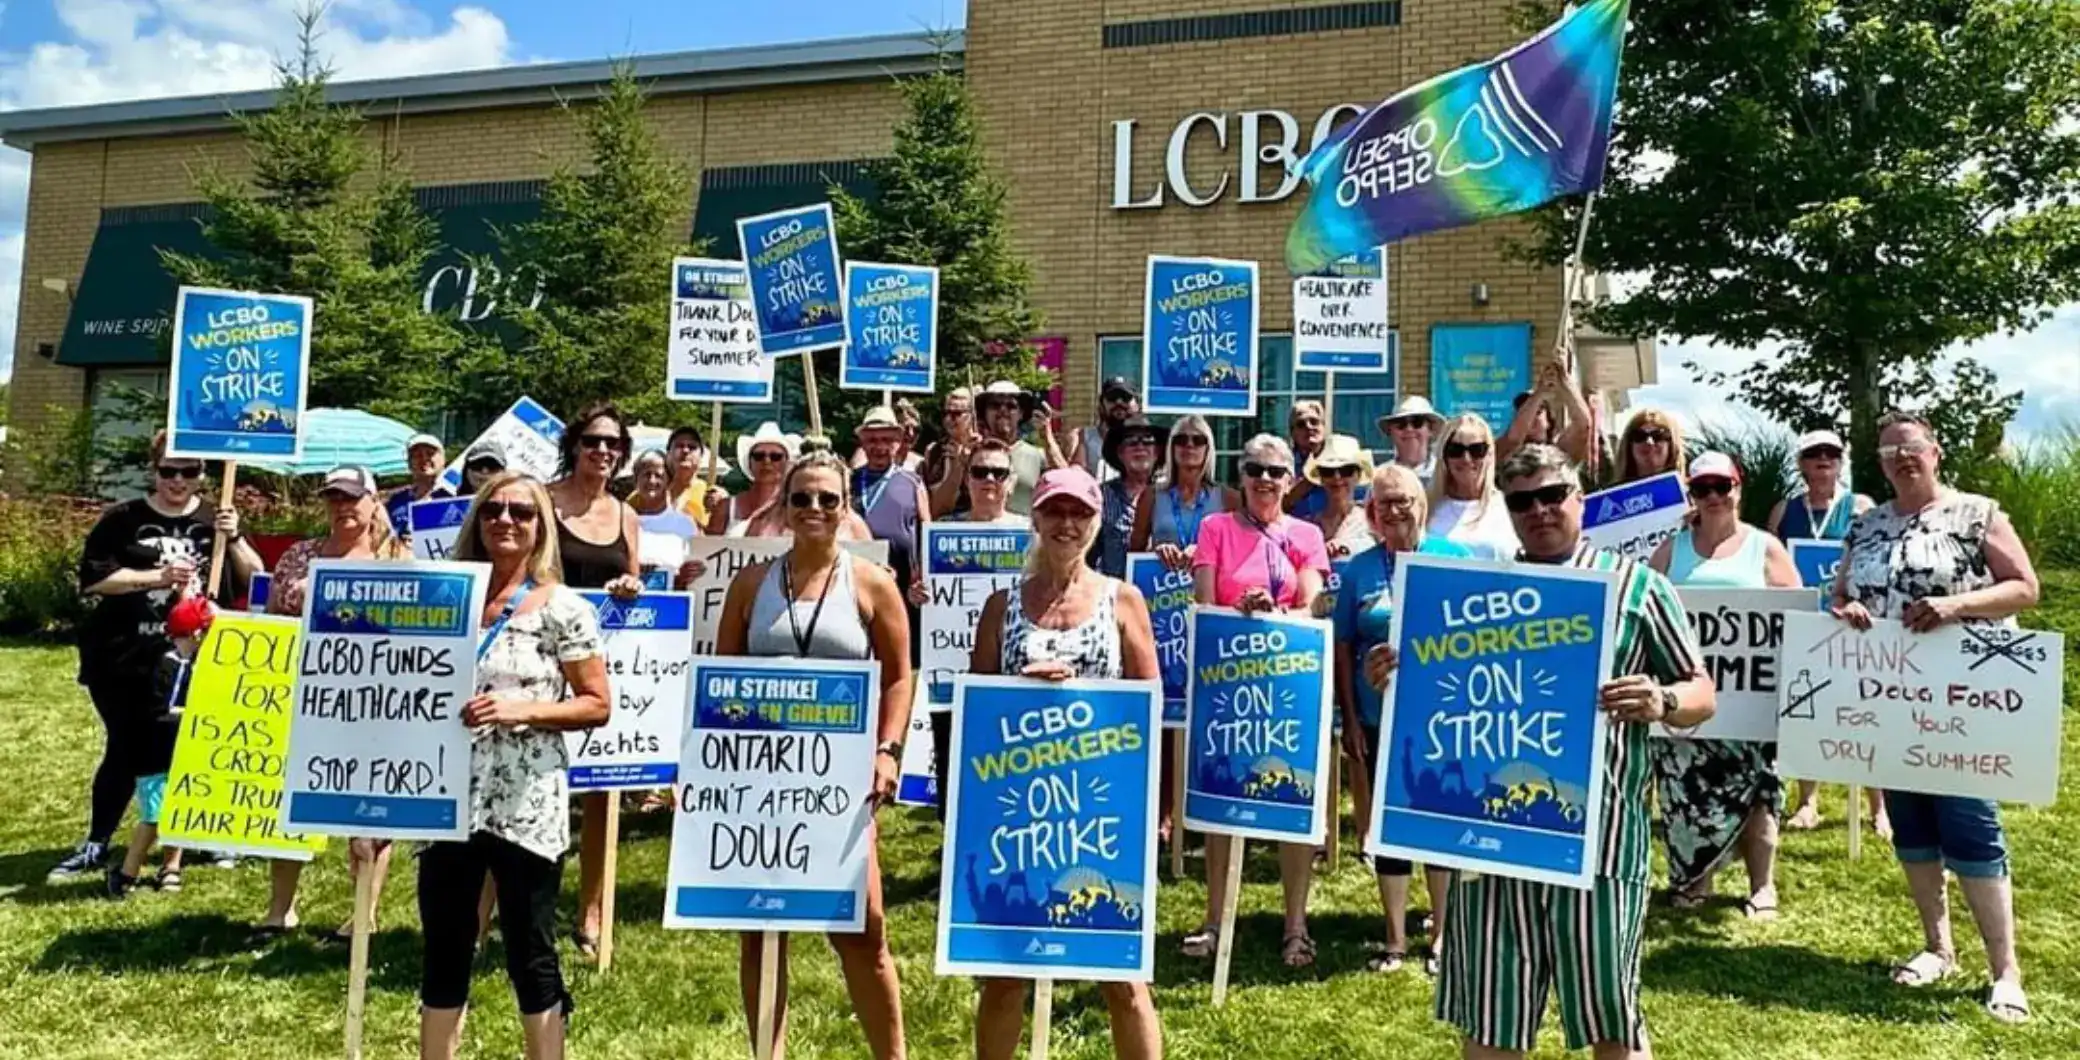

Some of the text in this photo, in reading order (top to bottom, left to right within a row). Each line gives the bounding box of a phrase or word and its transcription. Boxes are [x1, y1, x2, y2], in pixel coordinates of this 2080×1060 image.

[752, 226, 826, 268] WORKERS
[760, 219, 802, 248] LCBO
[780, 253, 805, 280] ON
[1172, 270, 1224, 293] LCBO
[768, 272, 827, 311] STRIKE
[852, 285, 929, 307] WORKERS
[866, 274, 908, 292] LCBO
[1157, 282, 1248, 313] WORKERS
[1300, 280, 1373, 298] HEALTHCARE
[84, 319, 126, 334] WINE
[207, 305, 268, 328] LCBO
[879, 304, 902, 323] ON
[1188, 306, 1217, 333] ON
[189, 320, 299, 350] WORKERS
[862, 323, 920, 348] STRIKE
[1299, 320, 1386, 339] CONVENIENCE
[226, 345, 260, 371] ON
[1168, 332, 1238, 362] STRIKE
[201, 372, 284, 402] STRIKE
[938, 536, 1016, 551] ON STRIKE!
[324, 580, 420, 603] ON STRIKE!
[932, 576, 981, 606] WE
[1153, 569, 1193, 592] LCB
[365, 605, 387, 626] EN
[1442, 586, 1541, 627] LCBO
[1219, 630, 1287, 658] LCBO
[1411, 614, 1594, 665] WORKERS
[1748, 611, 1784, 648] DR
[213, 627, 295, 674] DOU
[302, 638, 455, 677] LCBO FUNDS
[632, 645, 689, 683] Liquor
[1808, 627, 1922, 674] THANK
[1200, 650, 1320, 687] WORKERS
[1468, 658, 1523, 706] ON
[233, 671, 291, 715] FOR
[301, 685, 454, 722] HEALTHCARE
[619, 686, 655, 717] buy
[709, 677, 818, 701] ON STRIKE!
[1234, 681, 1273, 717] ON
[758, 703, 783, 724] EN
[1001, 700, 1094, 744] LCBO
[190, 714, 274, 747] IS AS
[577, 728, 660, 758] Yachts
[1205, 719, 1302, 756] STRIKE
[1424, 709, 1567, 762] STRIKE
[210, 745, 285, 777] CROO
[701, 732, 831, 777] ONTARIO
[970, 723, 1142, 783] WORKERS
[1819, 738, 2014, 778] DRY SUMMER
[173, 772, 212, 797] AS
[308, 744, 448, 795] STOP FORD!
[681, 782, 850, 817] CAN'T AFFORD
[1028, 769, 1081, 818] ON
[170, 807, 235, 835] HAIR
[710, 822, 810, 875] DOUG
[989, 816, 1120, 875] STRIKE
